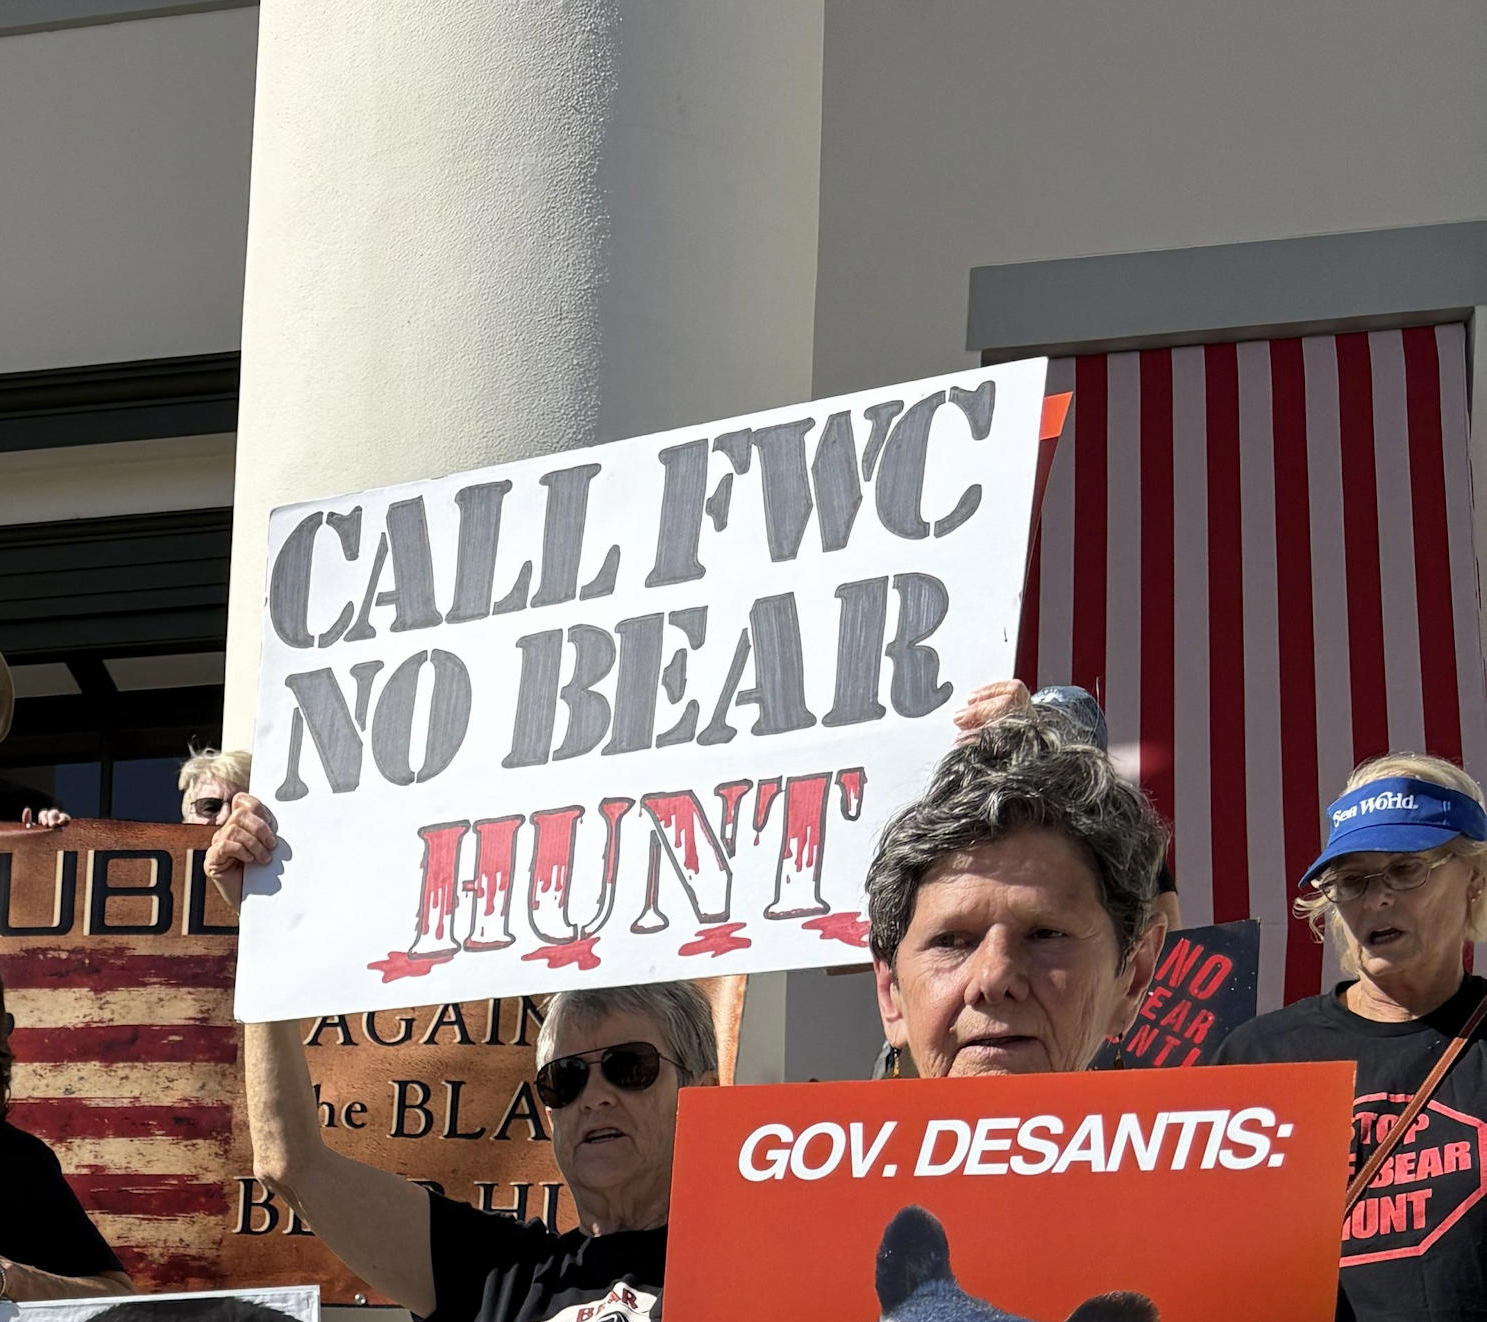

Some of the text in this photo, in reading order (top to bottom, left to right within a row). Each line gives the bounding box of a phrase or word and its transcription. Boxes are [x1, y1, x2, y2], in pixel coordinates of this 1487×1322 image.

[268, 380, 996, 649] CALL FWC
[276, 571, 954, 801] NO BEAR
[1332, 805, 1358, 828] Sea
[408, 766, 867, 961] HUNT
[1154, 937, 1233, 1000] NO
[1139, 986, 1215, 1044] EAR
[314, 1079, 551, 1141] he BLA
[737, 1106, 1295, 1183] GOV. DESANTIS:
